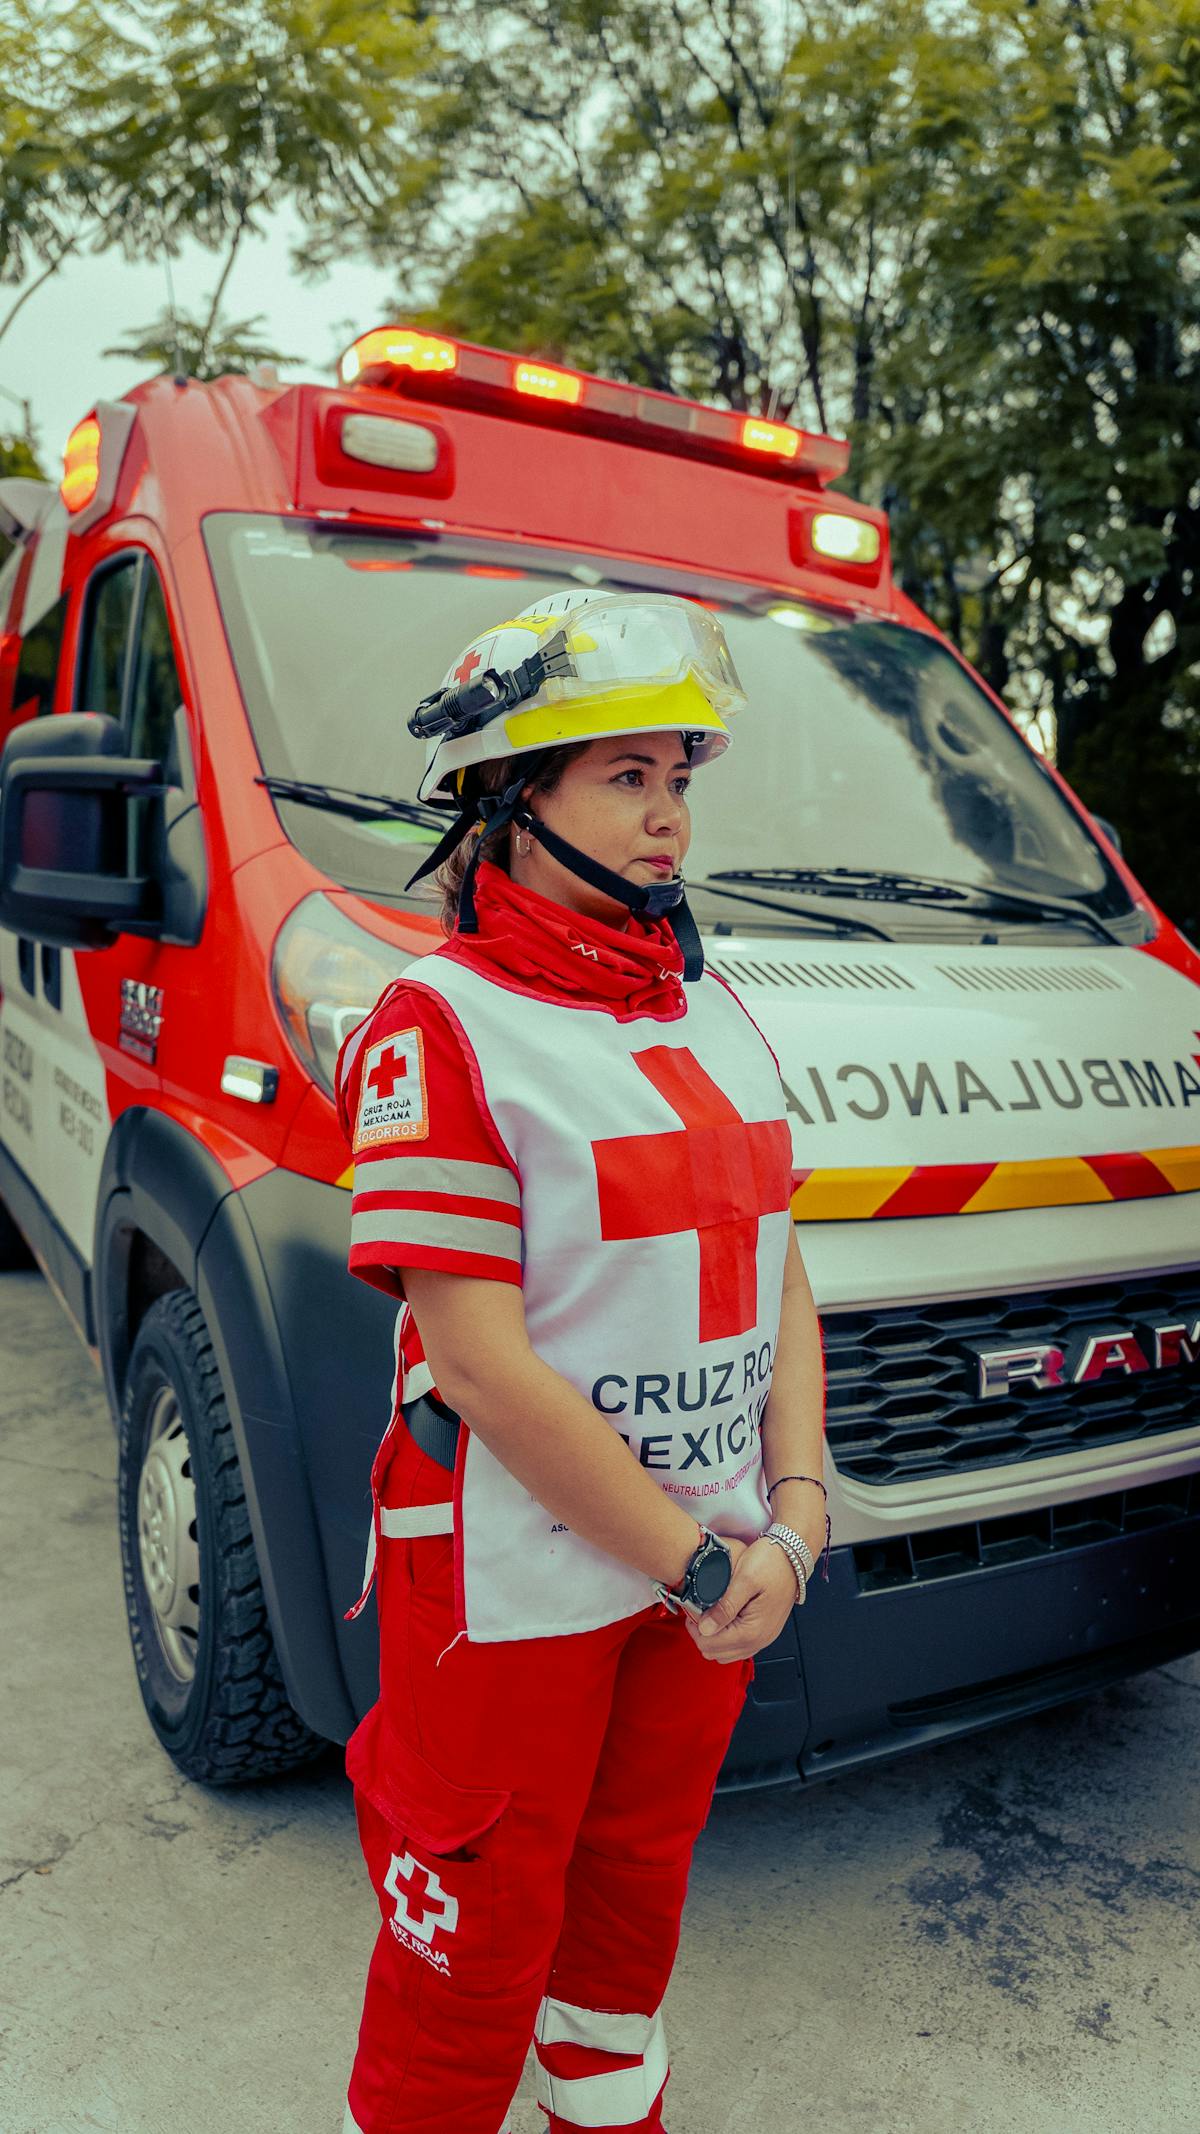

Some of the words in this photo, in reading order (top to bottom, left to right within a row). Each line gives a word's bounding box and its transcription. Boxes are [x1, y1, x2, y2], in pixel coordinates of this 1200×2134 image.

[363, 1104, 383, 1117] CRUZ
[387, 1098, 411, 1111] ROJA
[363, 1110, 411, 1128] MEXICANA
[357, 1123, 417, 1145] SOCORROS
[591, 1361, 735, 1415] CRUZ
[662, 1482, 720, 1498] NEUTRALIDAD
[411, 1936, 450, 1967] ROJA
